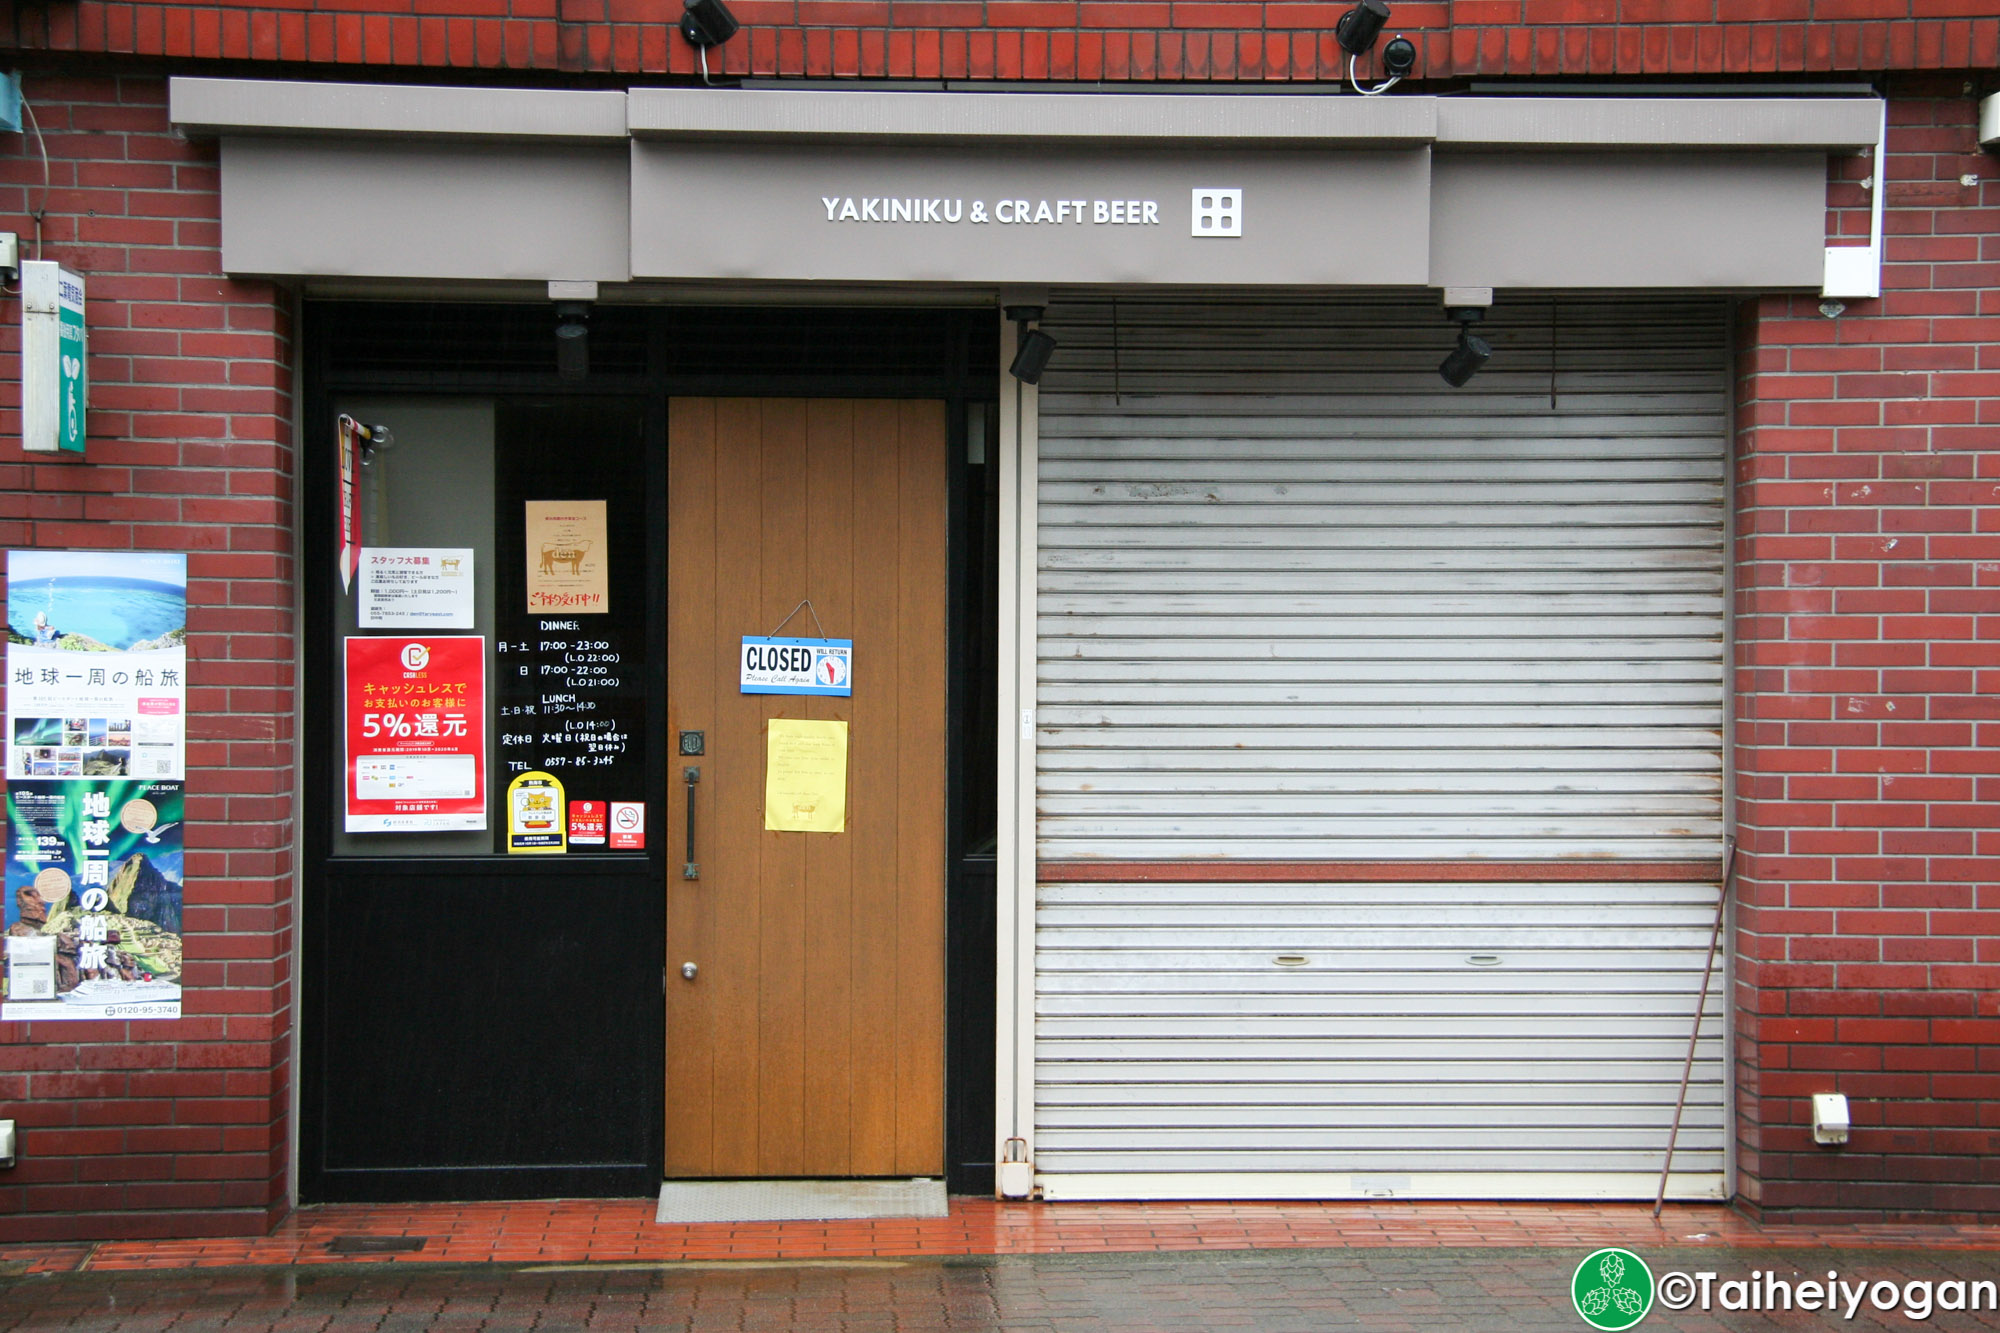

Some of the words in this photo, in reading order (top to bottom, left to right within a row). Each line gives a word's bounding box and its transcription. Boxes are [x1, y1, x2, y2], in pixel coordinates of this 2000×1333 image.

[822, 197, 963, 223] YAKINIKU
[969, 200, 989, 224] &
[995, 199, 1087, 224] CRAFT
[1093, 200, 1160, 224] BEER
[371, 556, 430, 565] スタッフ大募集
[540, 620, 580, 631] DINNER
[746, 646, 812, 672] CLOSED
[519, 666, 528, 676] 日
[14, 667, 180, 687] 地球一周の船旅
[746, 673, 769, 682] Please
[771, 675, 787, 683] Call
[789, 675, 810, 684] Again
[363, 682, 468, 695] キャッシュレスで
[363, 698, 467, 708] お支払いのお客様に
[542, 694, 576, 704] LUNCH
[362, 713, 468, 737] 5%還元
[502, 733, 533, 745] 定休日
[508, 761, 532, 771] TEL
[571, 822, 604, 831] 5%還元
[80, 791, 111, 969] 地球一周の船旅
[117, 1006, 178, 1014] 0120-95-3740
